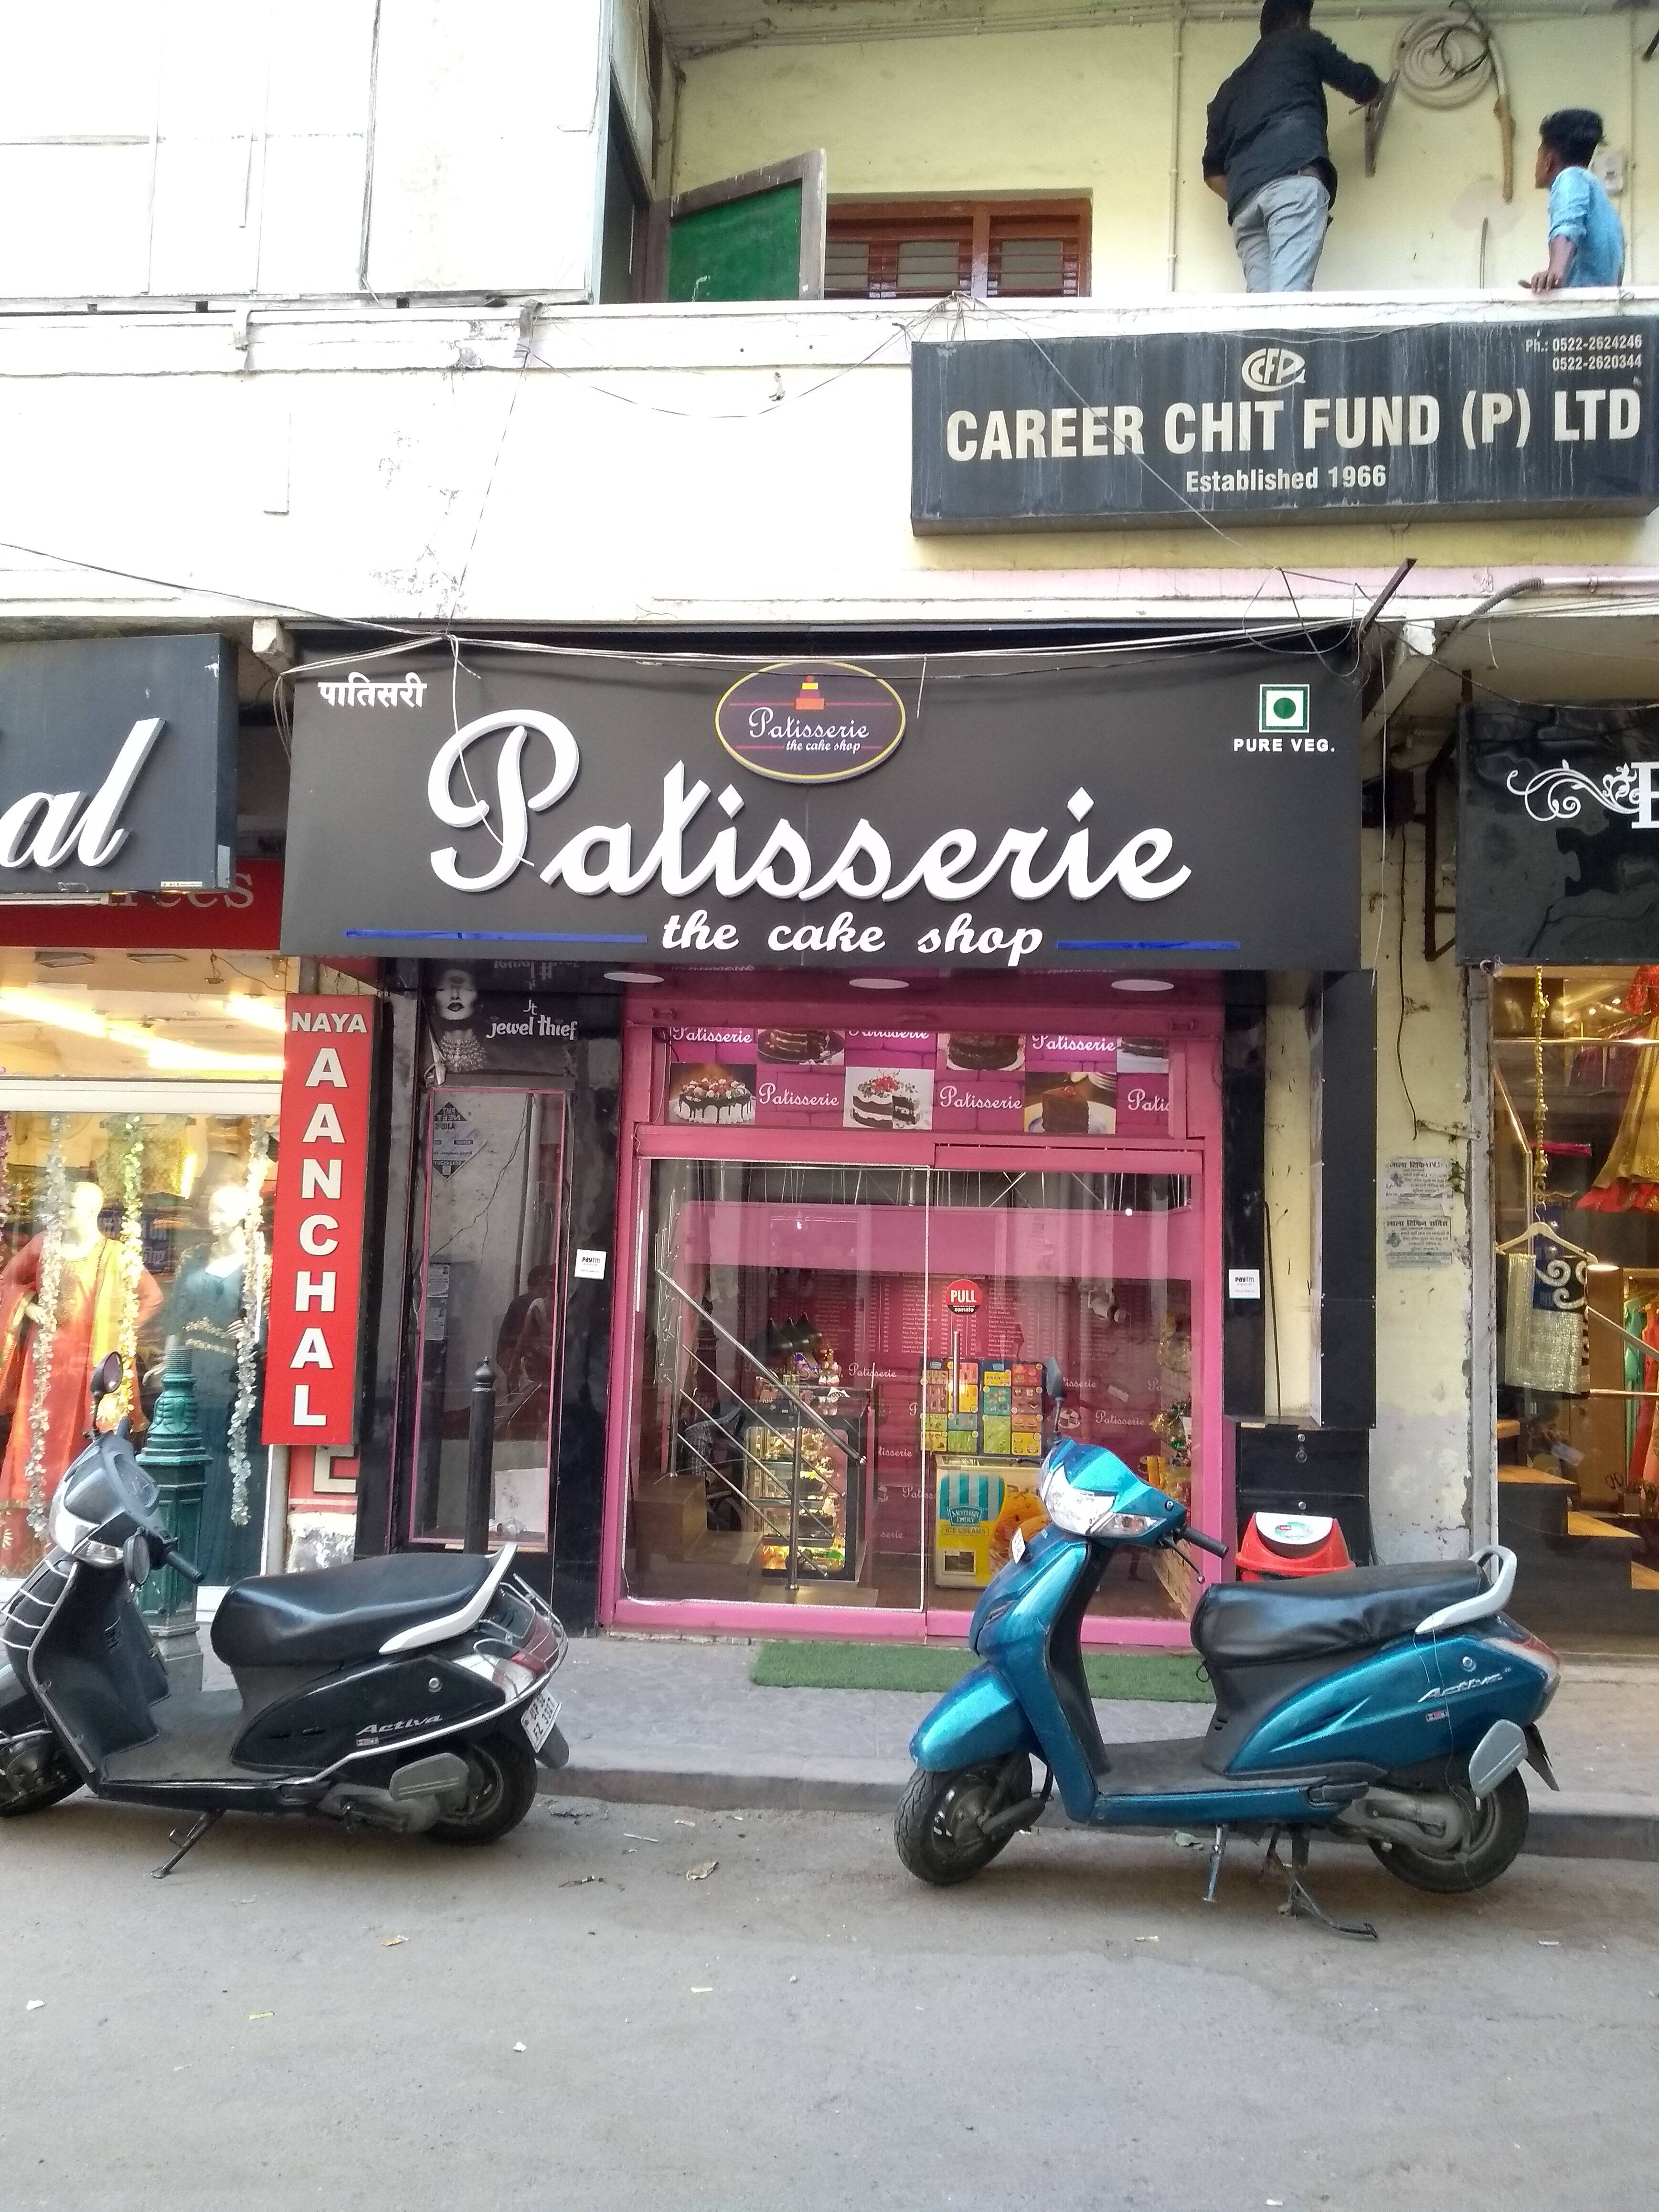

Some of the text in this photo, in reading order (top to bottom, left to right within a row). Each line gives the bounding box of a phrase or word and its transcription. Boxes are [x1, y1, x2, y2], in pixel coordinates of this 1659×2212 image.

[1526, 334, 1642, 352] Ph.: 0522-2624246
[1553, 353, 1642, 371] 0522-2620344
[946, 387, 1641, 463] CAREER CHIT FUND (P) LTD
[1185, 463, 1387, 494] Established 1966
[318, 671, 427, 707] पातिसरी
[748, 707, 870, 739] Patisserie
[785, 739, 861, 755] the cake shop
[1234, 738, 1336, 753] PURE VEG.
[427, 709, 1192, 901] Patisserie
[662, 909, 1043, 967] the cake shop
[291, 1011, 368, 1034] NAYA
[486, 1014, 578, 1041] jewel thief
[758, 1082, 840, 1106] Patisserie
[939, 1085, 1022, 1110] Patisserie
[289, 1047, 348, 1426] AANCHAL
[951, 1289, 977, 1303] PULL
[1095, 1410, 1146, 1426] Patisserie
[356, 1714, 443, 1735] Activa
